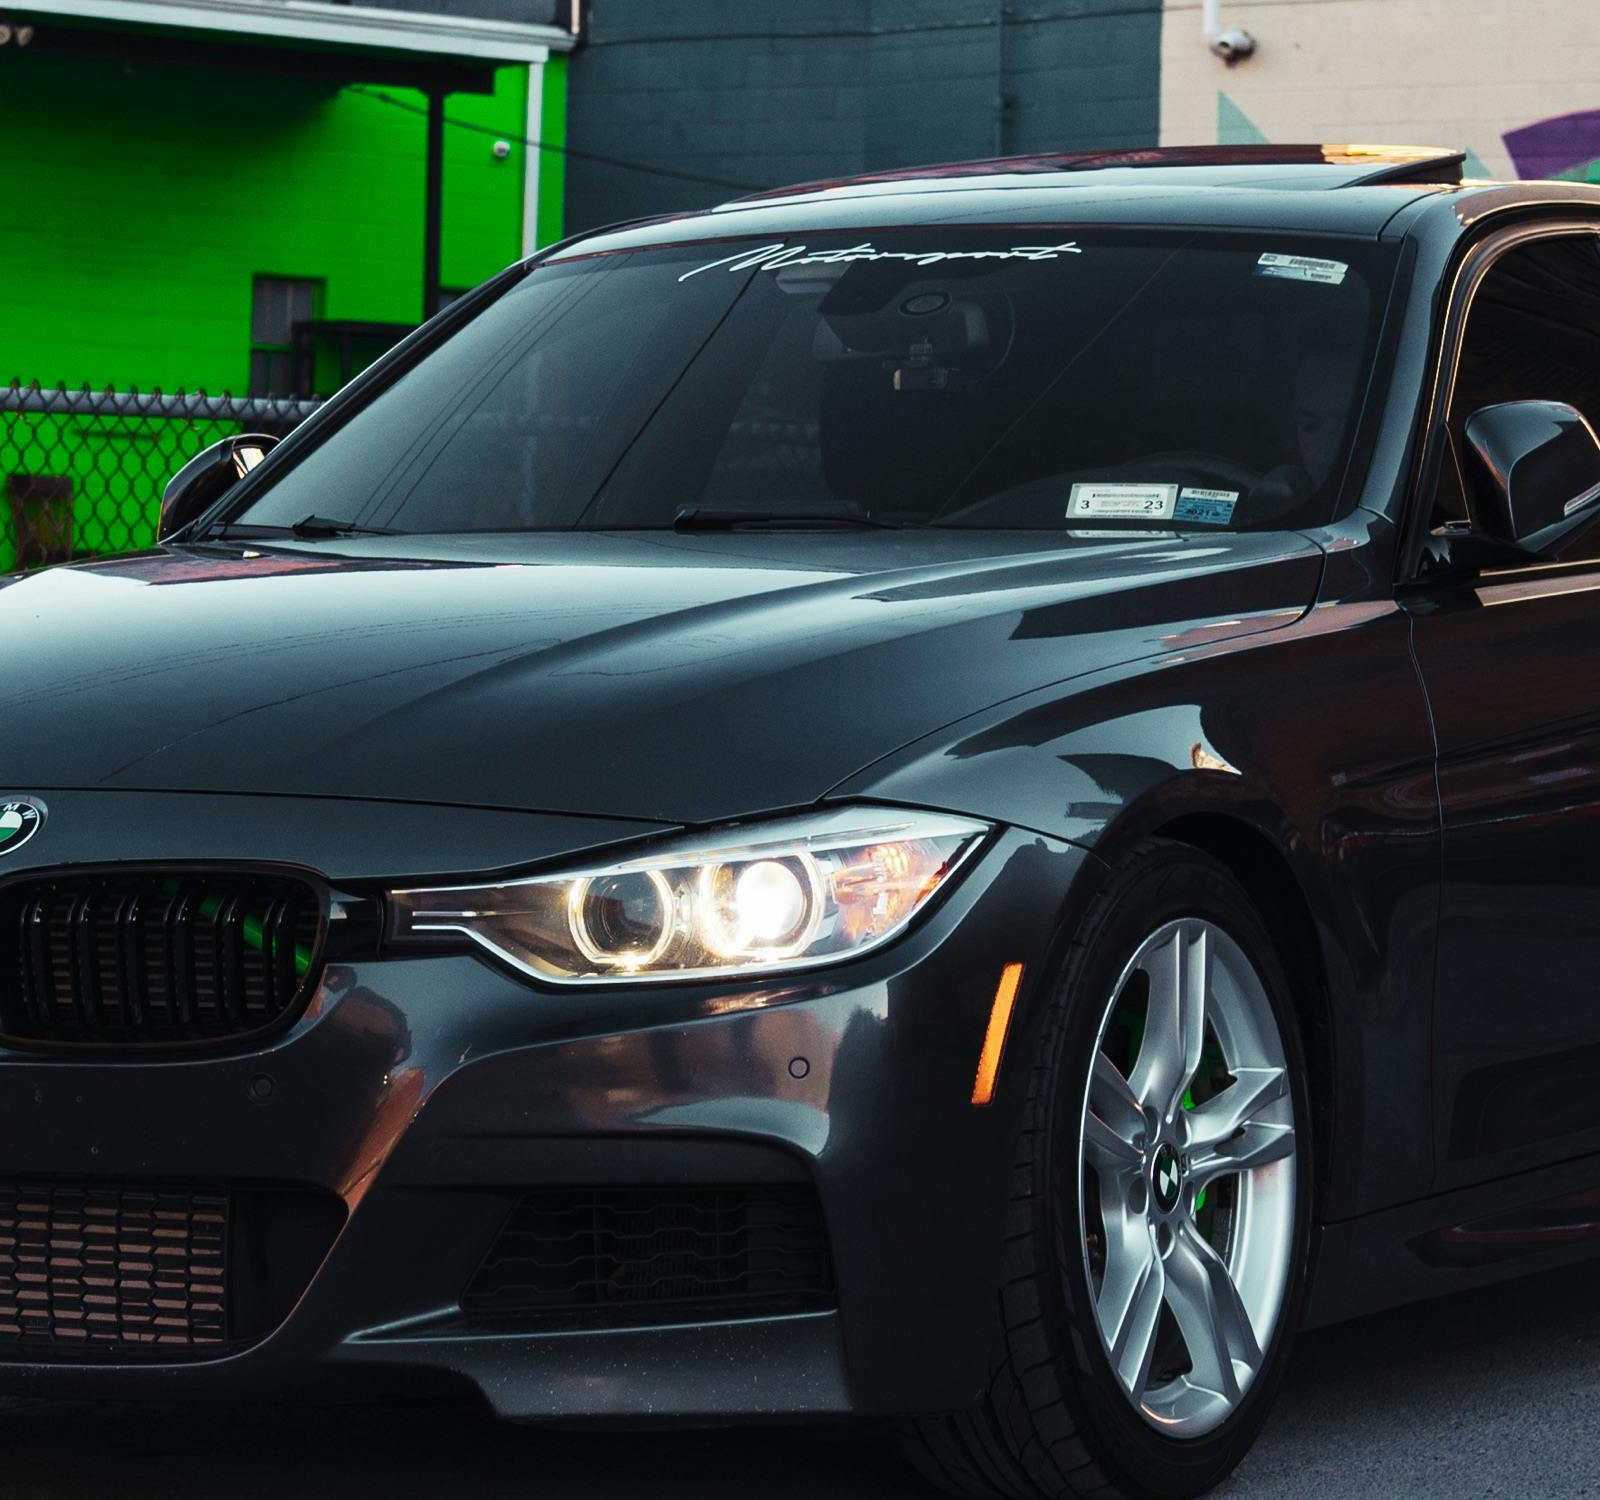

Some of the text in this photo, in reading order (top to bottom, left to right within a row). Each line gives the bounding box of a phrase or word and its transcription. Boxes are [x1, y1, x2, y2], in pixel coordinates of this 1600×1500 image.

[677, 241, 1083, 283] Motorsport
[1079, 499, 1164, 510] 3 23
